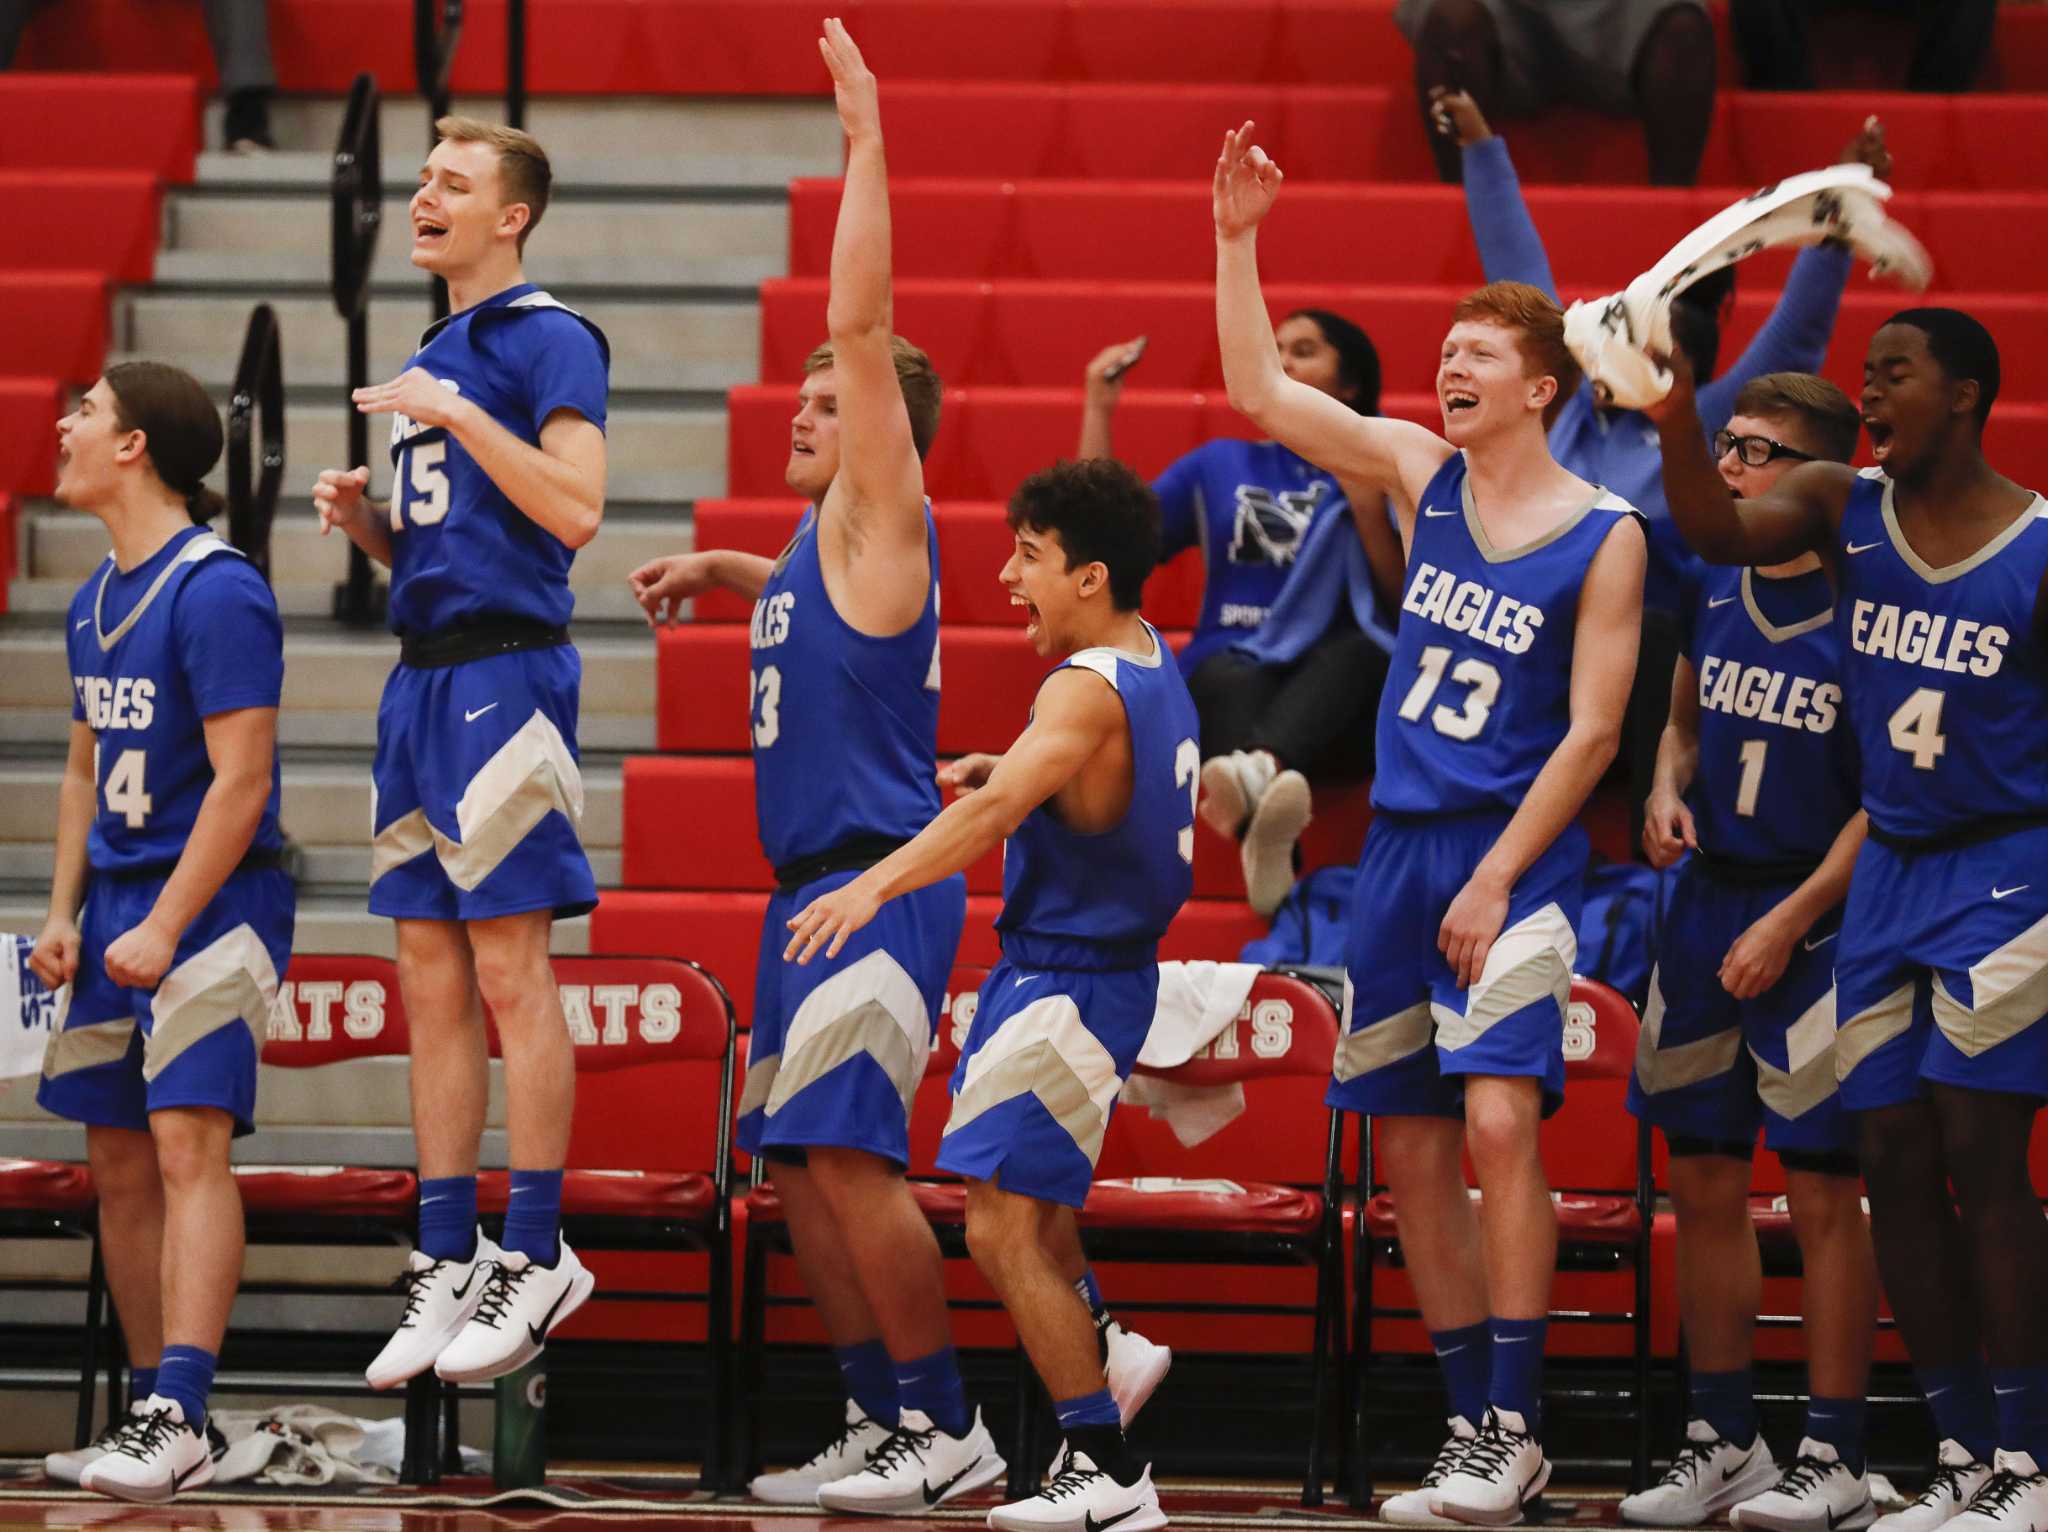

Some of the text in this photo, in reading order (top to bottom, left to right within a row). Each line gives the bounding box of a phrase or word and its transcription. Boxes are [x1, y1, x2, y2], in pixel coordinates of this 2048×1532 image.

[1402, 562, 1545, 655] EAGLES
[1852, 598, 2010, 678] EAGLES
[750, 664, 782, 748] 3
[1398, 646, 1502, 741] 13
[1699, 655, 1842, 734] EAGLES
[1887, 687, 1946, 770] 4
[94, 741, 152, 829] 4
[1736, 739, 1768, 817] 1
